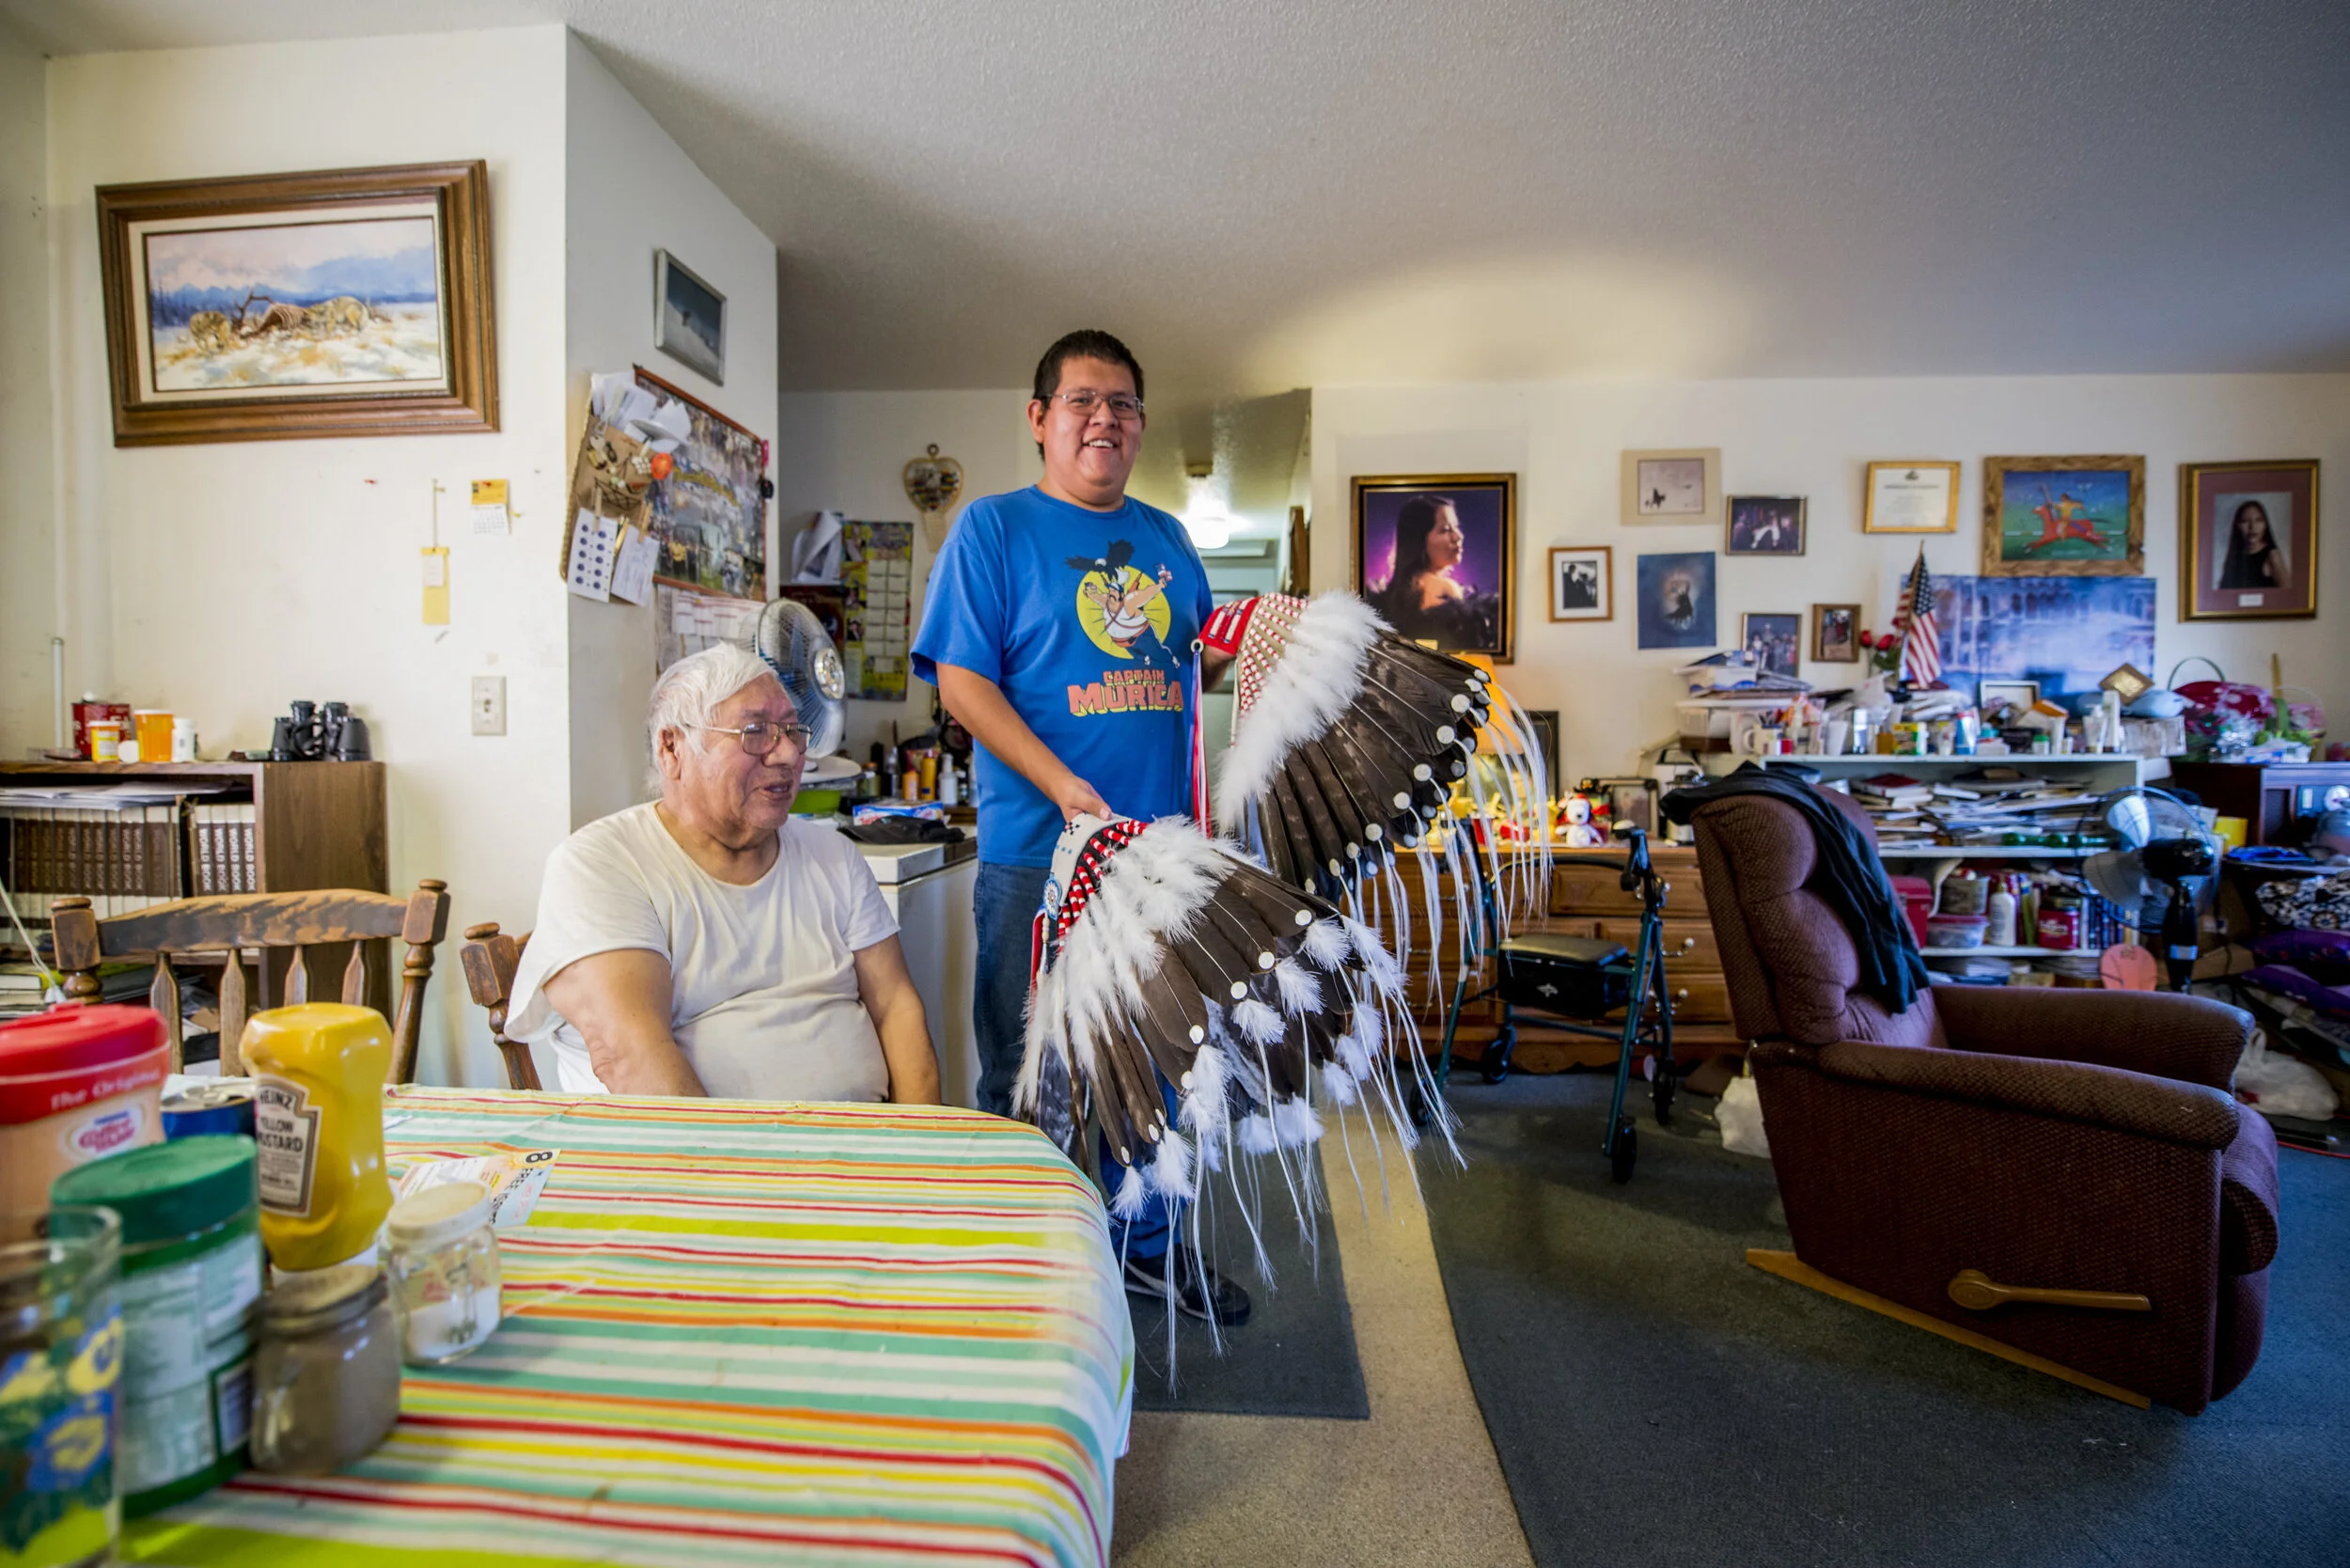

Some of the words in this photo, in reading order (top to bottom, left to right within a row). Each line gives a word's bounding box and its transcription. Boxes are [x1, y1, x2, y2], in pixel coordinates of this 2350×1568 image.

[1103, 668, 1165, 685] CAPTAIN
[1067, 681, 1184, 716] MURICA
[122, 828, 132, 862] WORLD
[133, 828, 143, 862] WORLD
[198, 828, 210, 862] WORLD
[213, 828, 226, 862] WORLD
[228, 828, 240, 862] WORLD
[243, 828, 255, 862] WORLD
[201, 863, 212, 891] BOOK
[216, 863, 227, 891] BOOK
[230, 863, 242, 891] BOOK
[245, 863, 256, 891] BOOK
[260, 1090, 292, 1110] HEINZ
[256, 1132, 304, 1152] USTARD
[525, 1151, 553, 1164] 8
